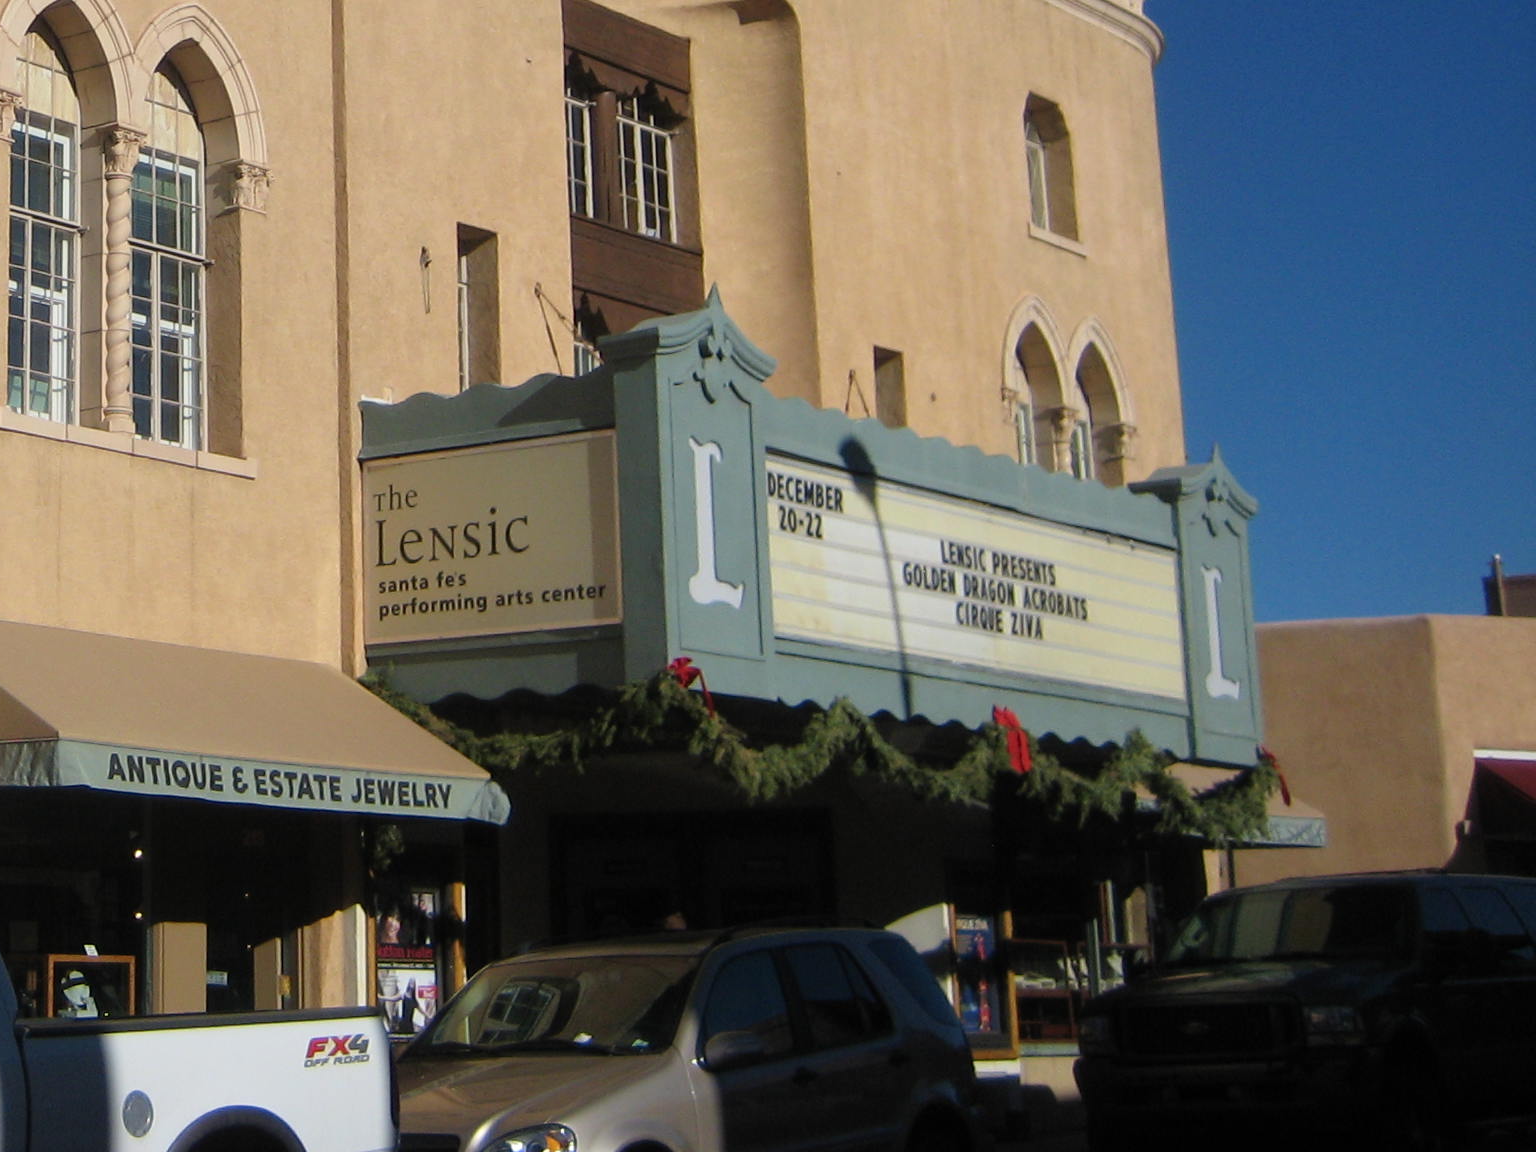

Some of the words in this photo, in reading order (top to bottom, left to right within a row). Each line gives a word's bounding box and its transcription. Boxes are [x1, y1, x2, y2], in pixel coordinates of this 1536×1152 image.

[373, 484, 418, 512] The
[767, 472, 843, 513] DECEMBER
[779, 504, 823, 539] 20-22
[940, 539, 986, 572] LENSIC
[992, 551, 1057, 586] PRESENTS
[379, 575, 429, 594] santa
[437, 571, 467, 588] fe's
[902, 561, 956, 594] GOLDEN
[963, 573, 1017, 607] DRAGON
[1023, 586, 1088, 621] ACROBATS
[379, 595, 488, 621] performing
[495, 589, 533, 608] arts
[542, 584, 606, 603] center
[955, 601, 1003, 633] CIRQUE
[1011, 612, 1043, 640] ZIVA
[107, 753, 224, 792] ANTIQUE
[231, 766, 249, 794] &
[253, 768, 342, 803] ESTATE
[351, 776, 453, 810] JEWELRY
[304, 1057, 329, 1068] OFF
[333, 1054, 369, 1065] ROAD
[305, 1033, 370, 1058] FX4
